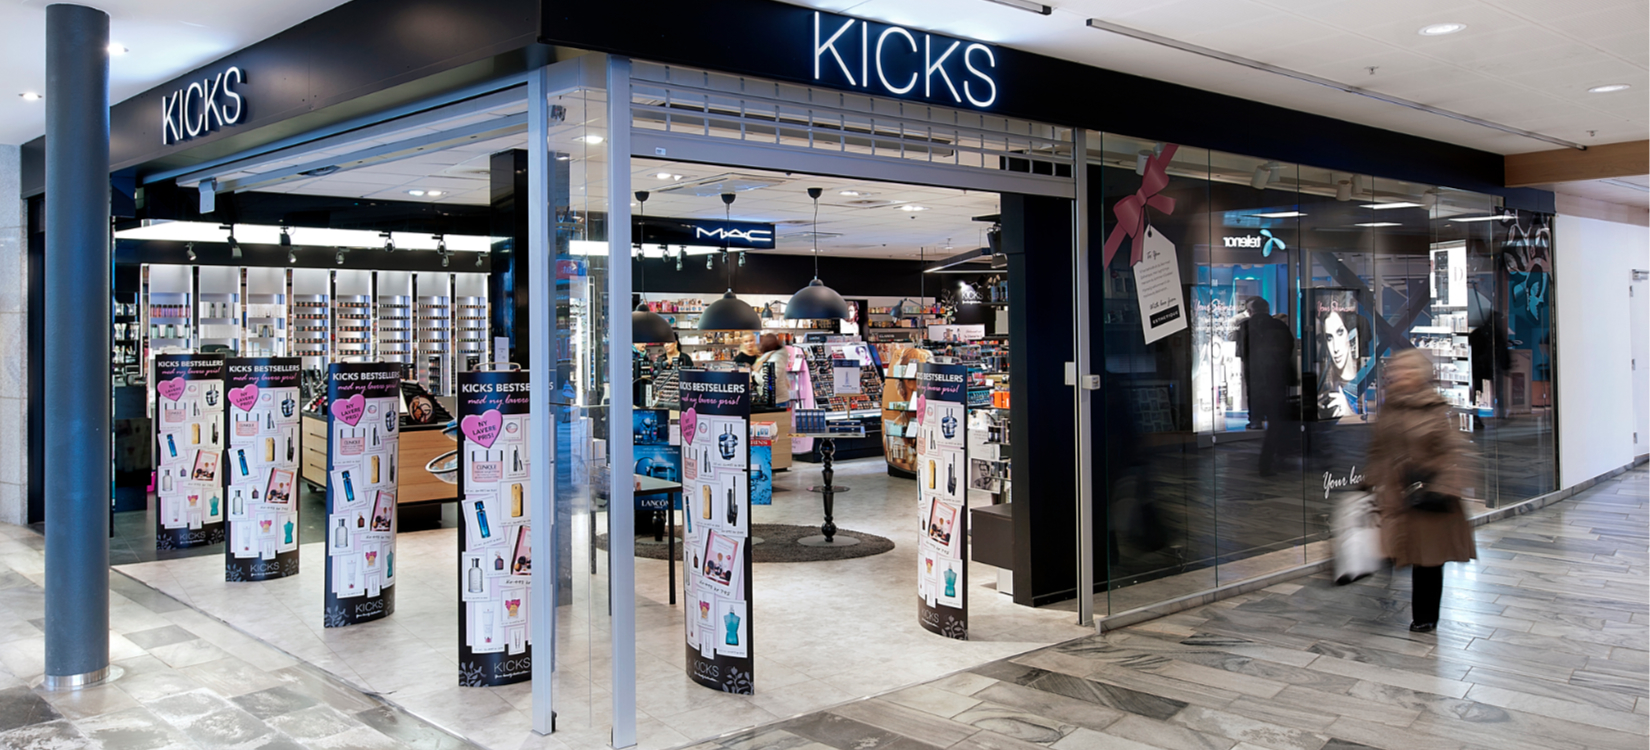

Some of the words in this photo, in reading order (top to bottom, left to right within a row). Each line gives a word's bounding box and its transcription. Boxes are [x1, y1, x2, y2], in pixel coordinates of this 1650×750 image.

[814, 11, 997, 107] KICKS
[162, 66, 243, 145] KICKS
[333, 372, 359, 380] KICKS
[361, 371, 399, 380] BESTSELLERS
[462, 384, 493, 393] KICKS
[693, 383, 745, 394] BESTSELLERS
[472, 425, 497, 436] LAVERE
[477, 433, 494, 441] PRIS!
[1322, 471, 1348, 499] Your
[180, 531, 206, 540] KICKS
[250, 561, 280, 572] KICKS
[355, 599, 384, 613] KICKS
[493, 657, 531, 673] KICKS
[694, 658, 720, 677] KICKS
